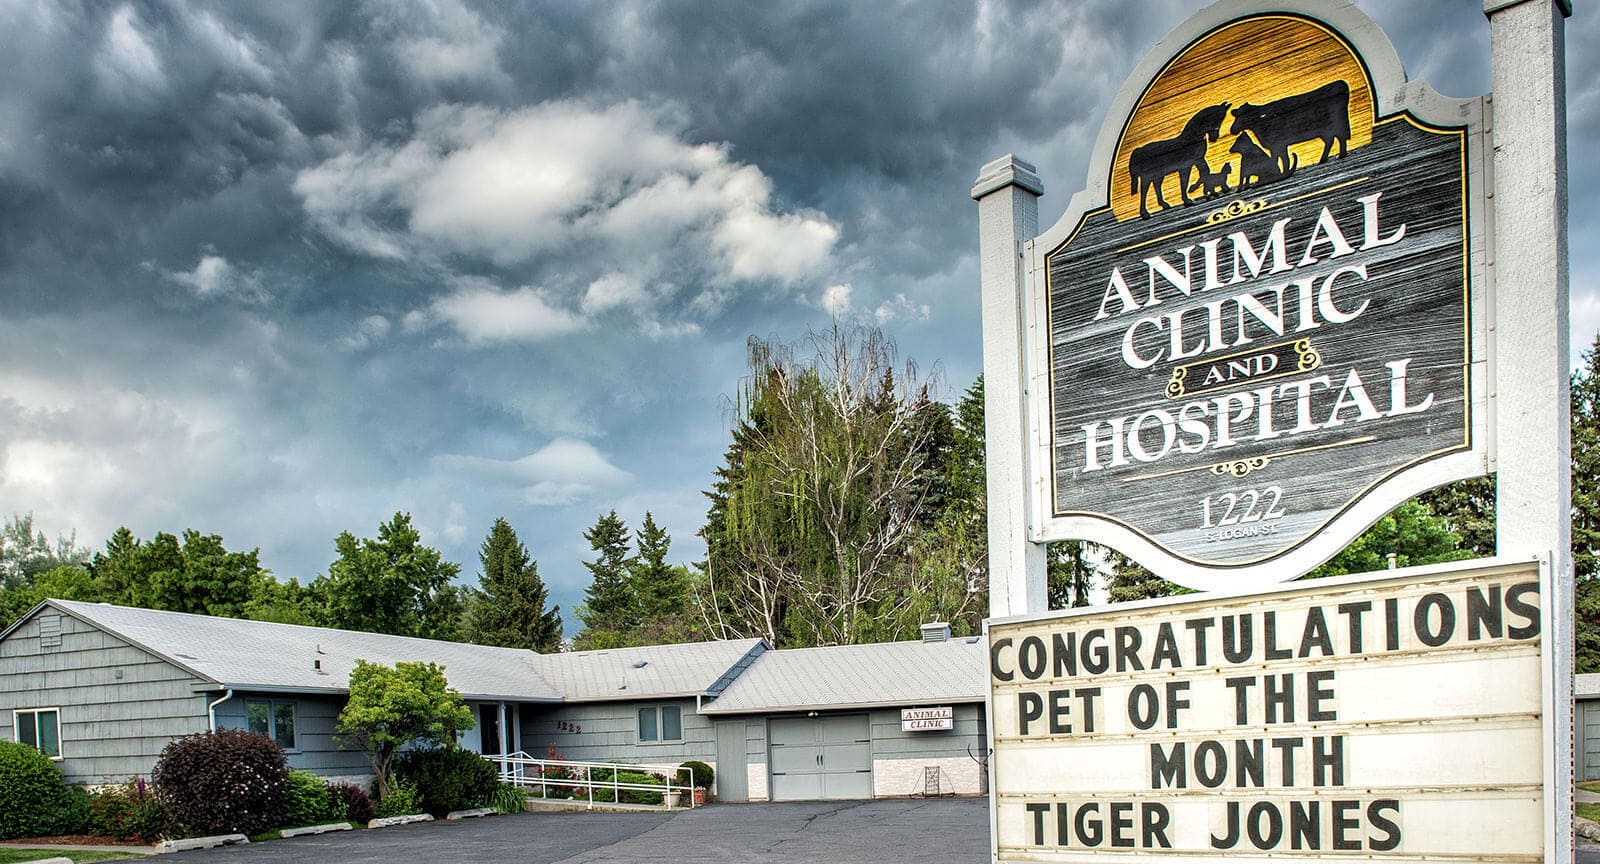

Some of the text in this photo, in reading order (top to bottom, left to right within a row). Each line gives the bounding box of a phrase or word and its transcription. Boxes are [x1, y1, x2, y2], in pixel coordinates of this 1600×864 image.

[1093, 191, 1407, 321] ANIMAL
[1121, 264, 1372, 370] CLINIC
[1202, 352, 1279, 386] AND
[1081, 358, 1435, 473] HOSPITAL
[1198, 486, 1287, 530] 1222
[1220, 526, 1259, 540] LOGAN
[990, 581, 1541, 682] CONGRATULATIONS
[557, 720, 582, 734] 1222
[905, 710, 949, 719] ANIMAL
[910, 720, 944, 729] CLINIC
[1018, 670, 1338, 735] PET OF THE
[1150, 735, 1344, 789] MONTH
[1026, 799, 1402, 851] TIGER JONES
